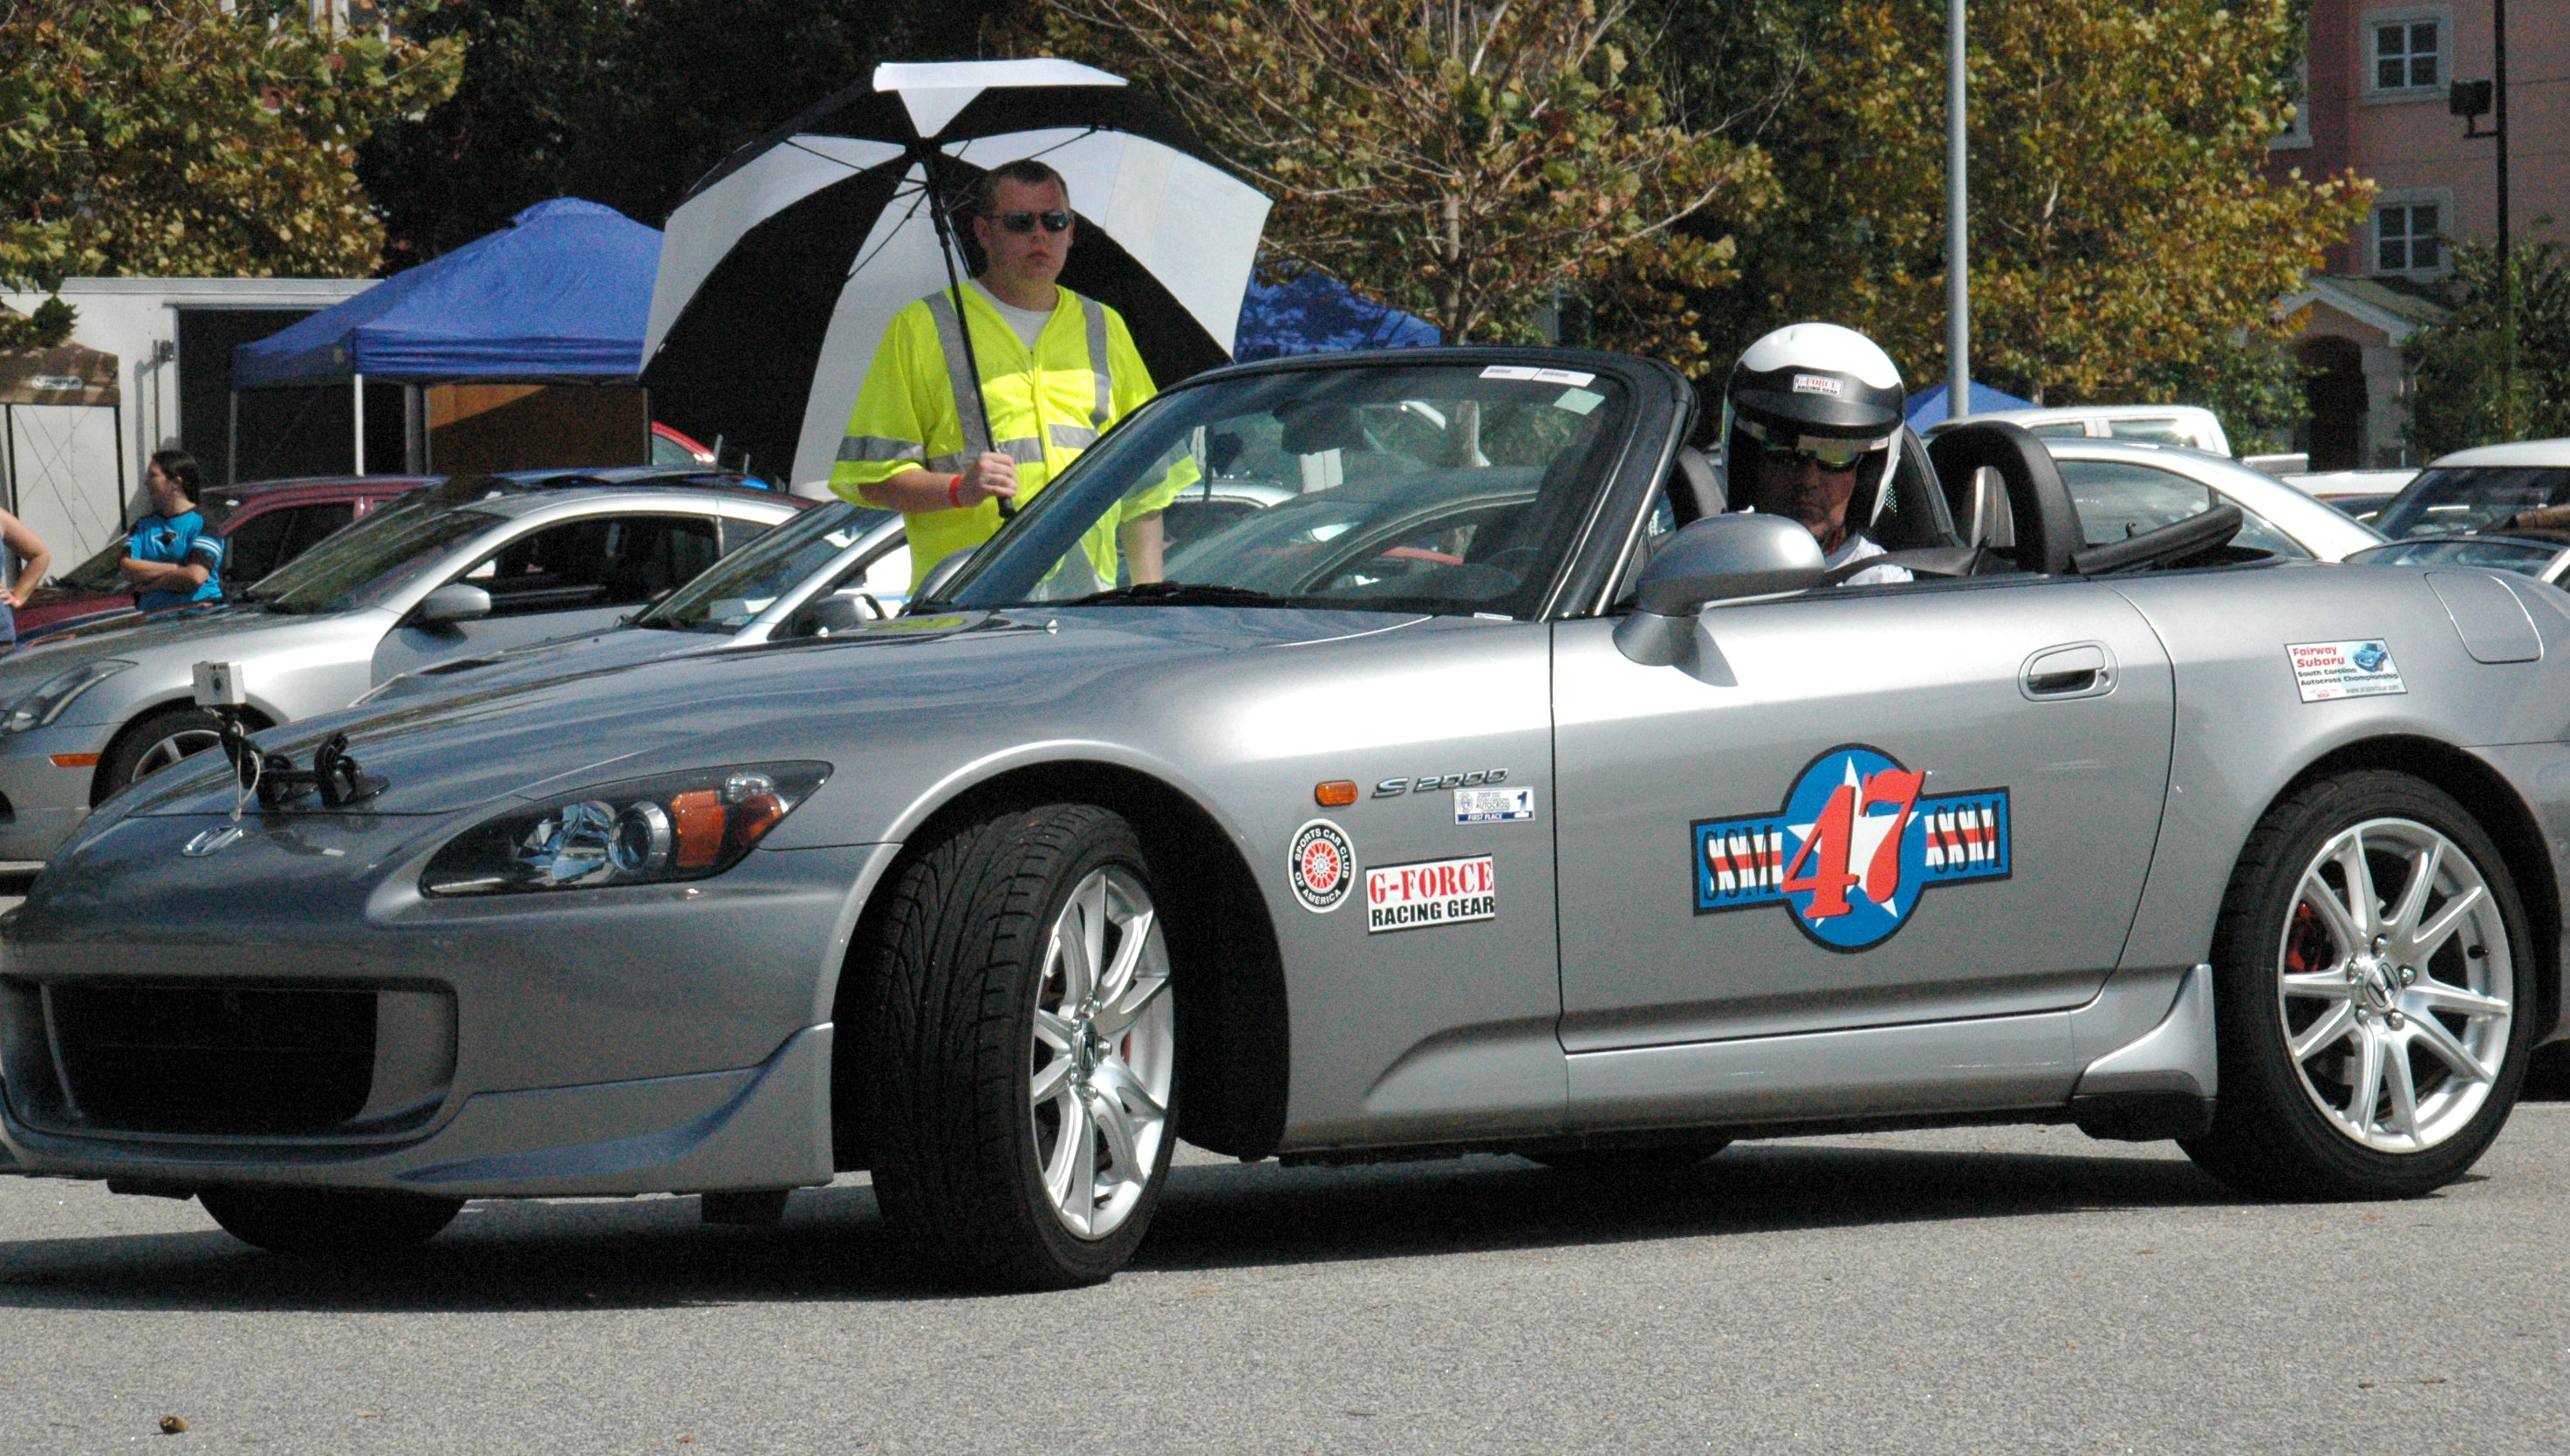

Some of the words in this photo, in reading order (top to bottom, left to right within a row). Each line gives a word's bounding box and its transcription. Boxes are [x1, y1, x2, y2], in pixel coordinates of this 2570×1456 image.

[2293, 646, 2337, 656] Fairway
[2297, 656, 2345, 667] Subaru
[2298, 668, 2322, 677] South
[2324, 666, 2357, 675] Carolina
[2300, 677, 2342, 686] Autocross
[2343, 673, 2399, 682] Championship
[1514, 791, 1529, 818] 1
[1295, 828, 1321, 861] SPORTS
[1323, 830, 1342, 846] CAR
[1339, 846, 1350, 878] CLUB
[1703, 824, 1775, 901] SSM
[1781, 769, 1925, 919] 47
[1933, 800, 2002, 873] SSM
[1295, 872, 1305, 887] OF
[1302, 888, 1342, 906] AMERICA
[1370, 861, 1493, 905] G-FORCE
[1372, 900, 1442, 927] RACING
[1447, 896, 1494, 919] GEAR
